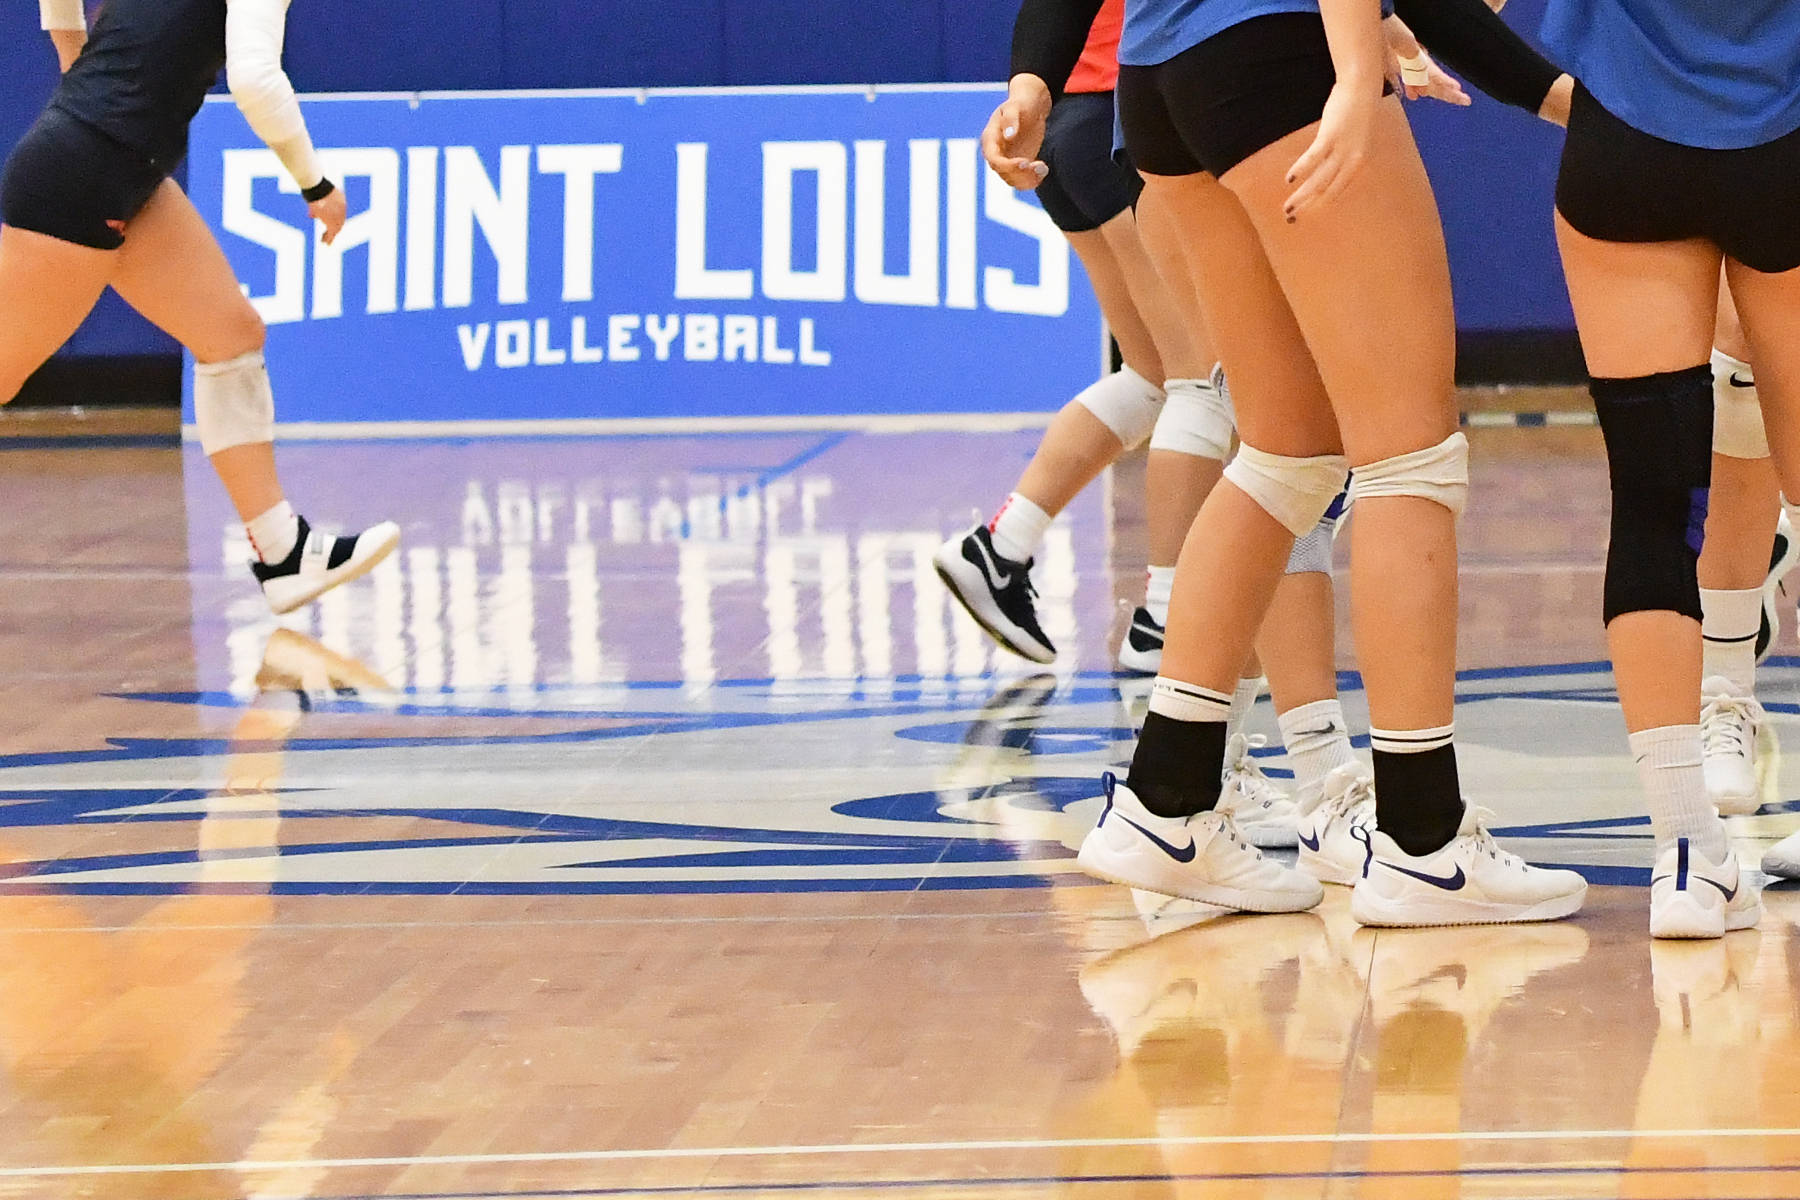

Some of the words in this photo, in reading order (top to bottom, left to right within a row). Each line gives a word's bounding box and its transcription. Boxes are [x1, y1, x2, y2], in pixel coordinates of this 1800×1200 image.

[222, 142, 624, 324] SAINT
[675, 139, 1070, 317] LOUIS
[457, 313, 833, 371] VOLLEYBALL
